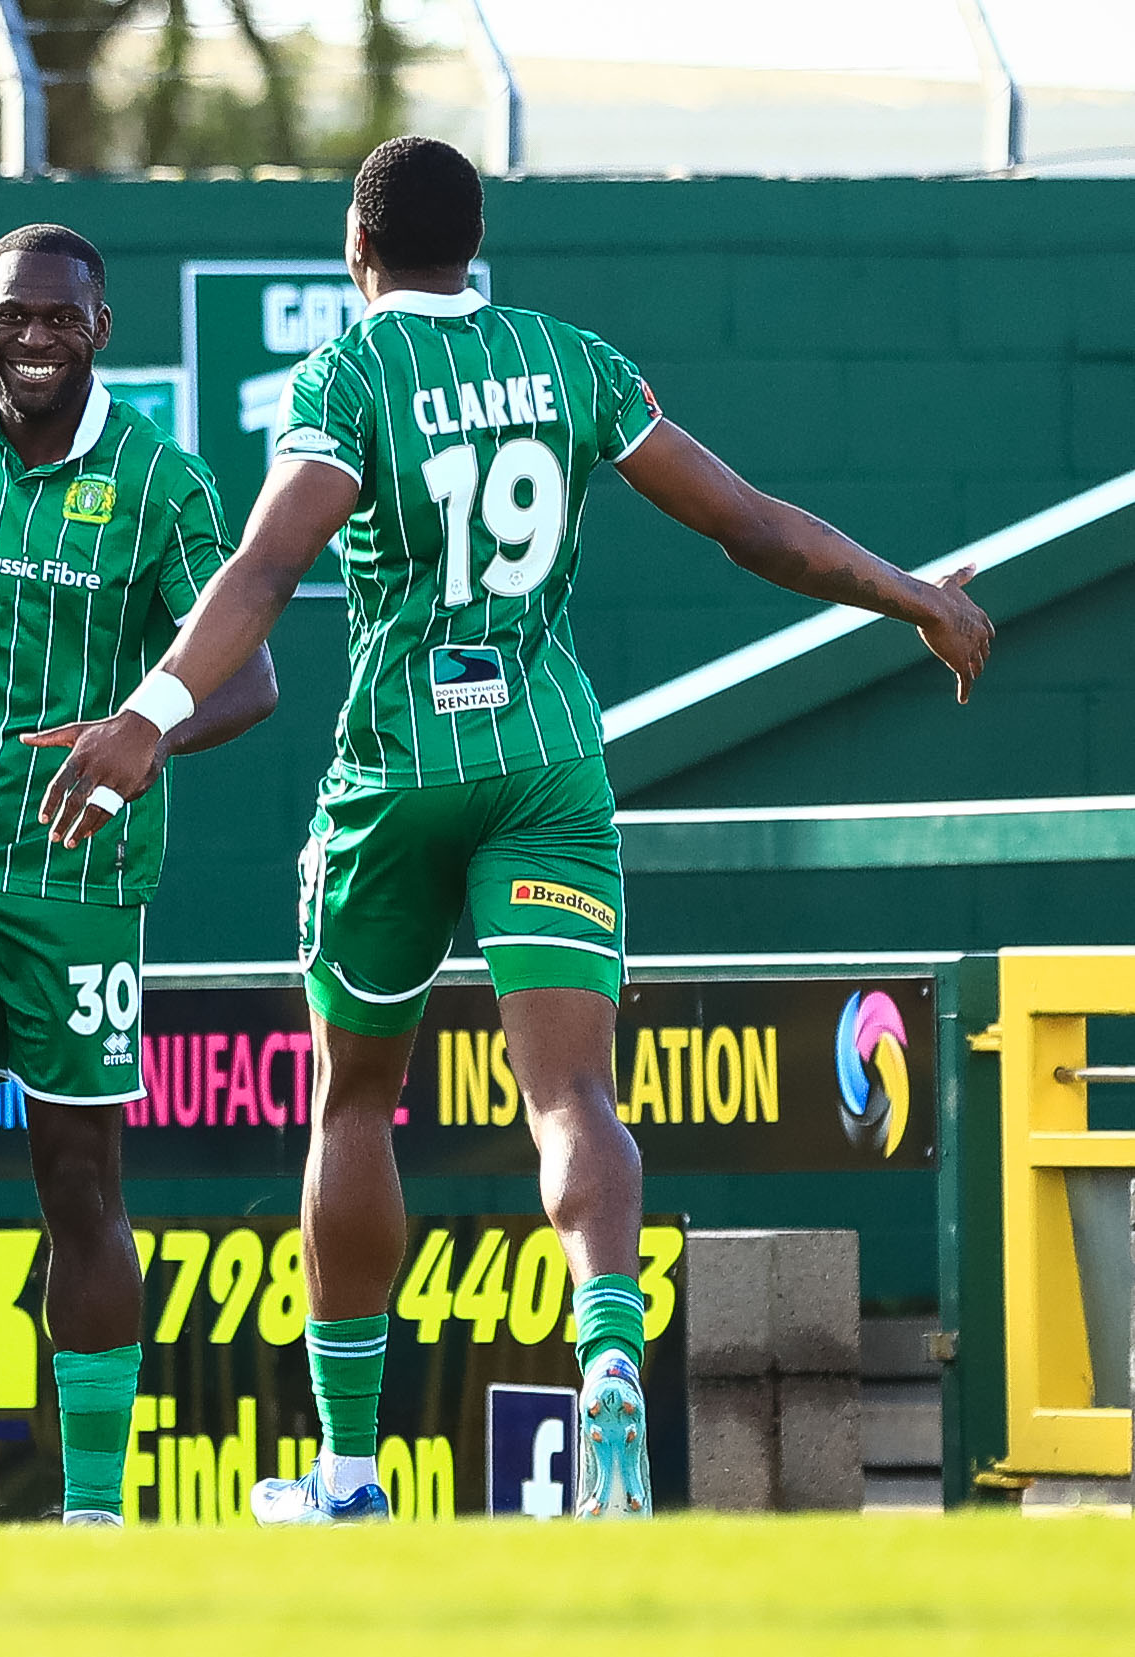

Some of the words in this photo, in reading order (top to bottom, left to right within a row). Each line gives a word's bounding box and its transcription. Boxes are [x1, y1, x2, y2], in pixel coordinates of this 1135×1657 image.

[262, 284, 366, 354] GAT
[414, 374, 558, 435] CLARKE
[421, 438, 565, 606] 19
[42, 559, 101, 590] Fibre
[437, 692, 506, 711] RENTALS
[532, 885, 613, 926] Bradfords
[67, 961, 138, 1035] 30
[437, 1026, 780, 1126] INSATION
[122, 1396, 257, 1526] Find
